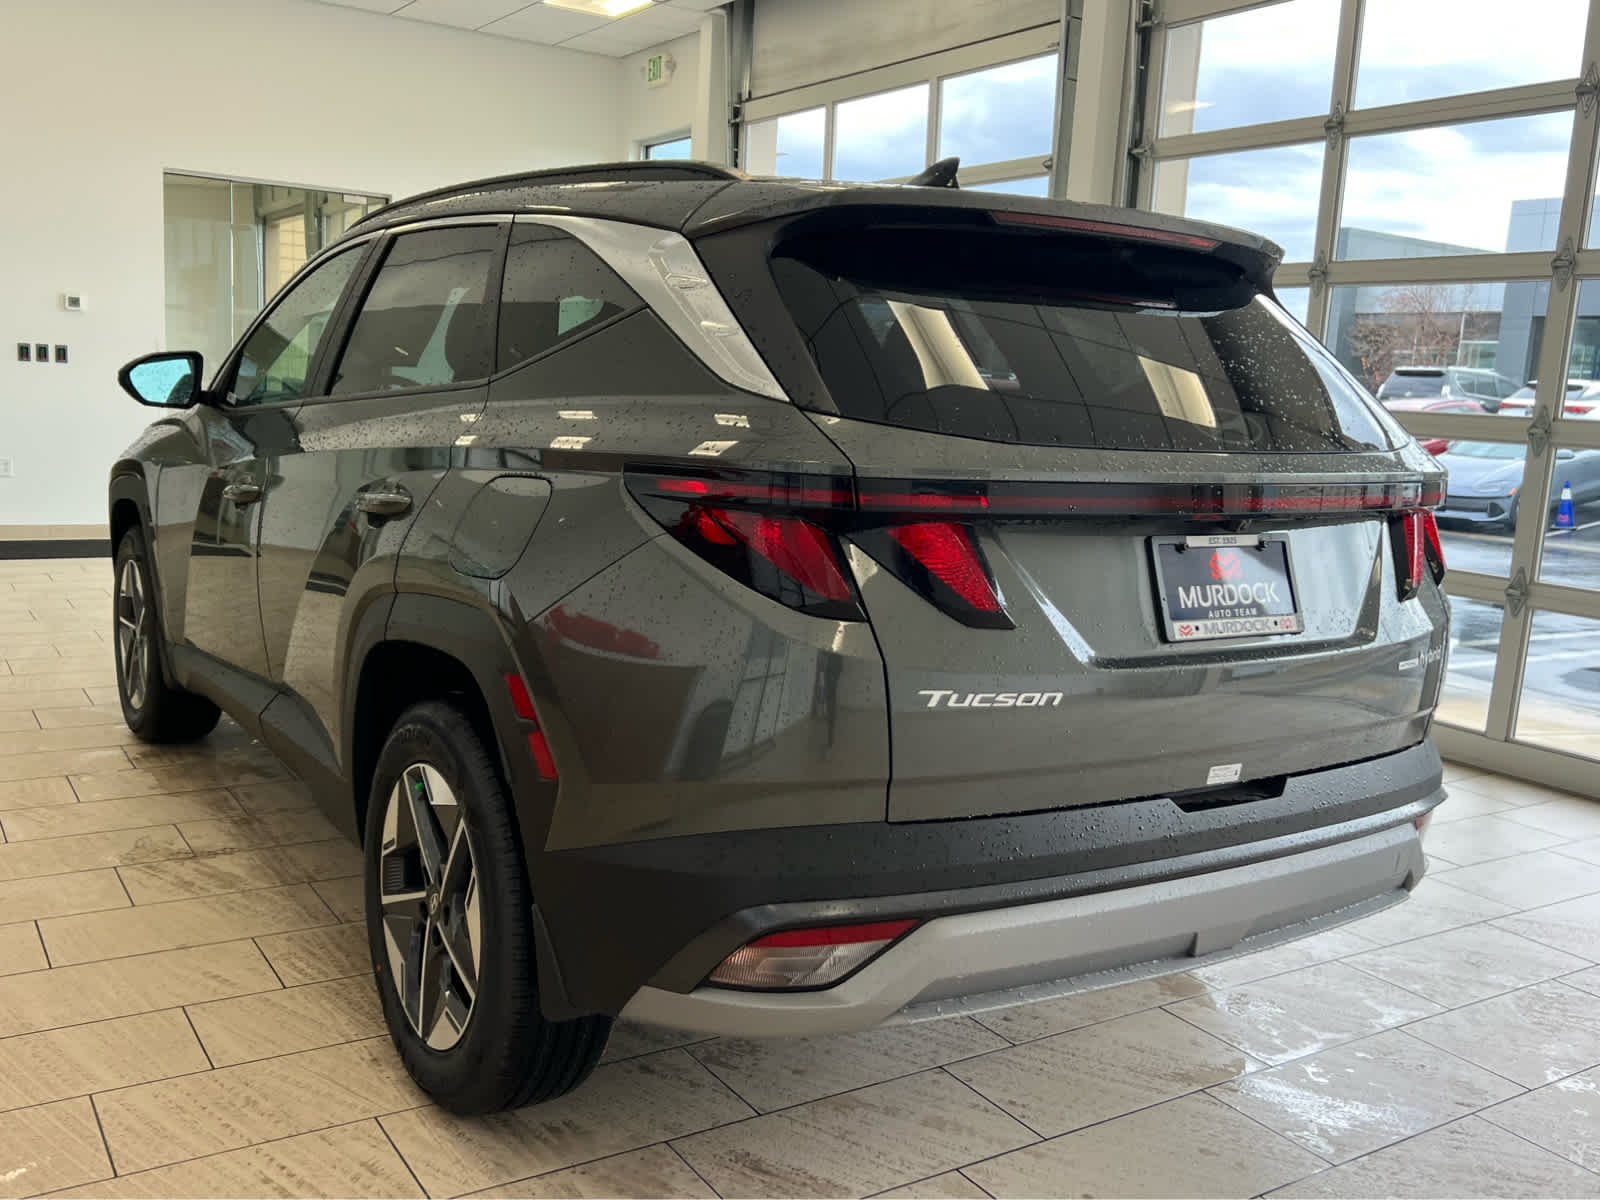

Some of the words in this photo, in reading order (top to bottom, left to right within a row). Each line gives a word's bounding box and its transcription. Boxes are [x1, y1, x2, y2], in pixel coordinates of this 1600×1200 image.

[1178, 581, 1281, 609] MURDOCK
[1208, 609, 1231, 618] AUTO
[1234, 608, 1257, 616] TEAM
[1204, 620, 1271, 634] MURDOCK
